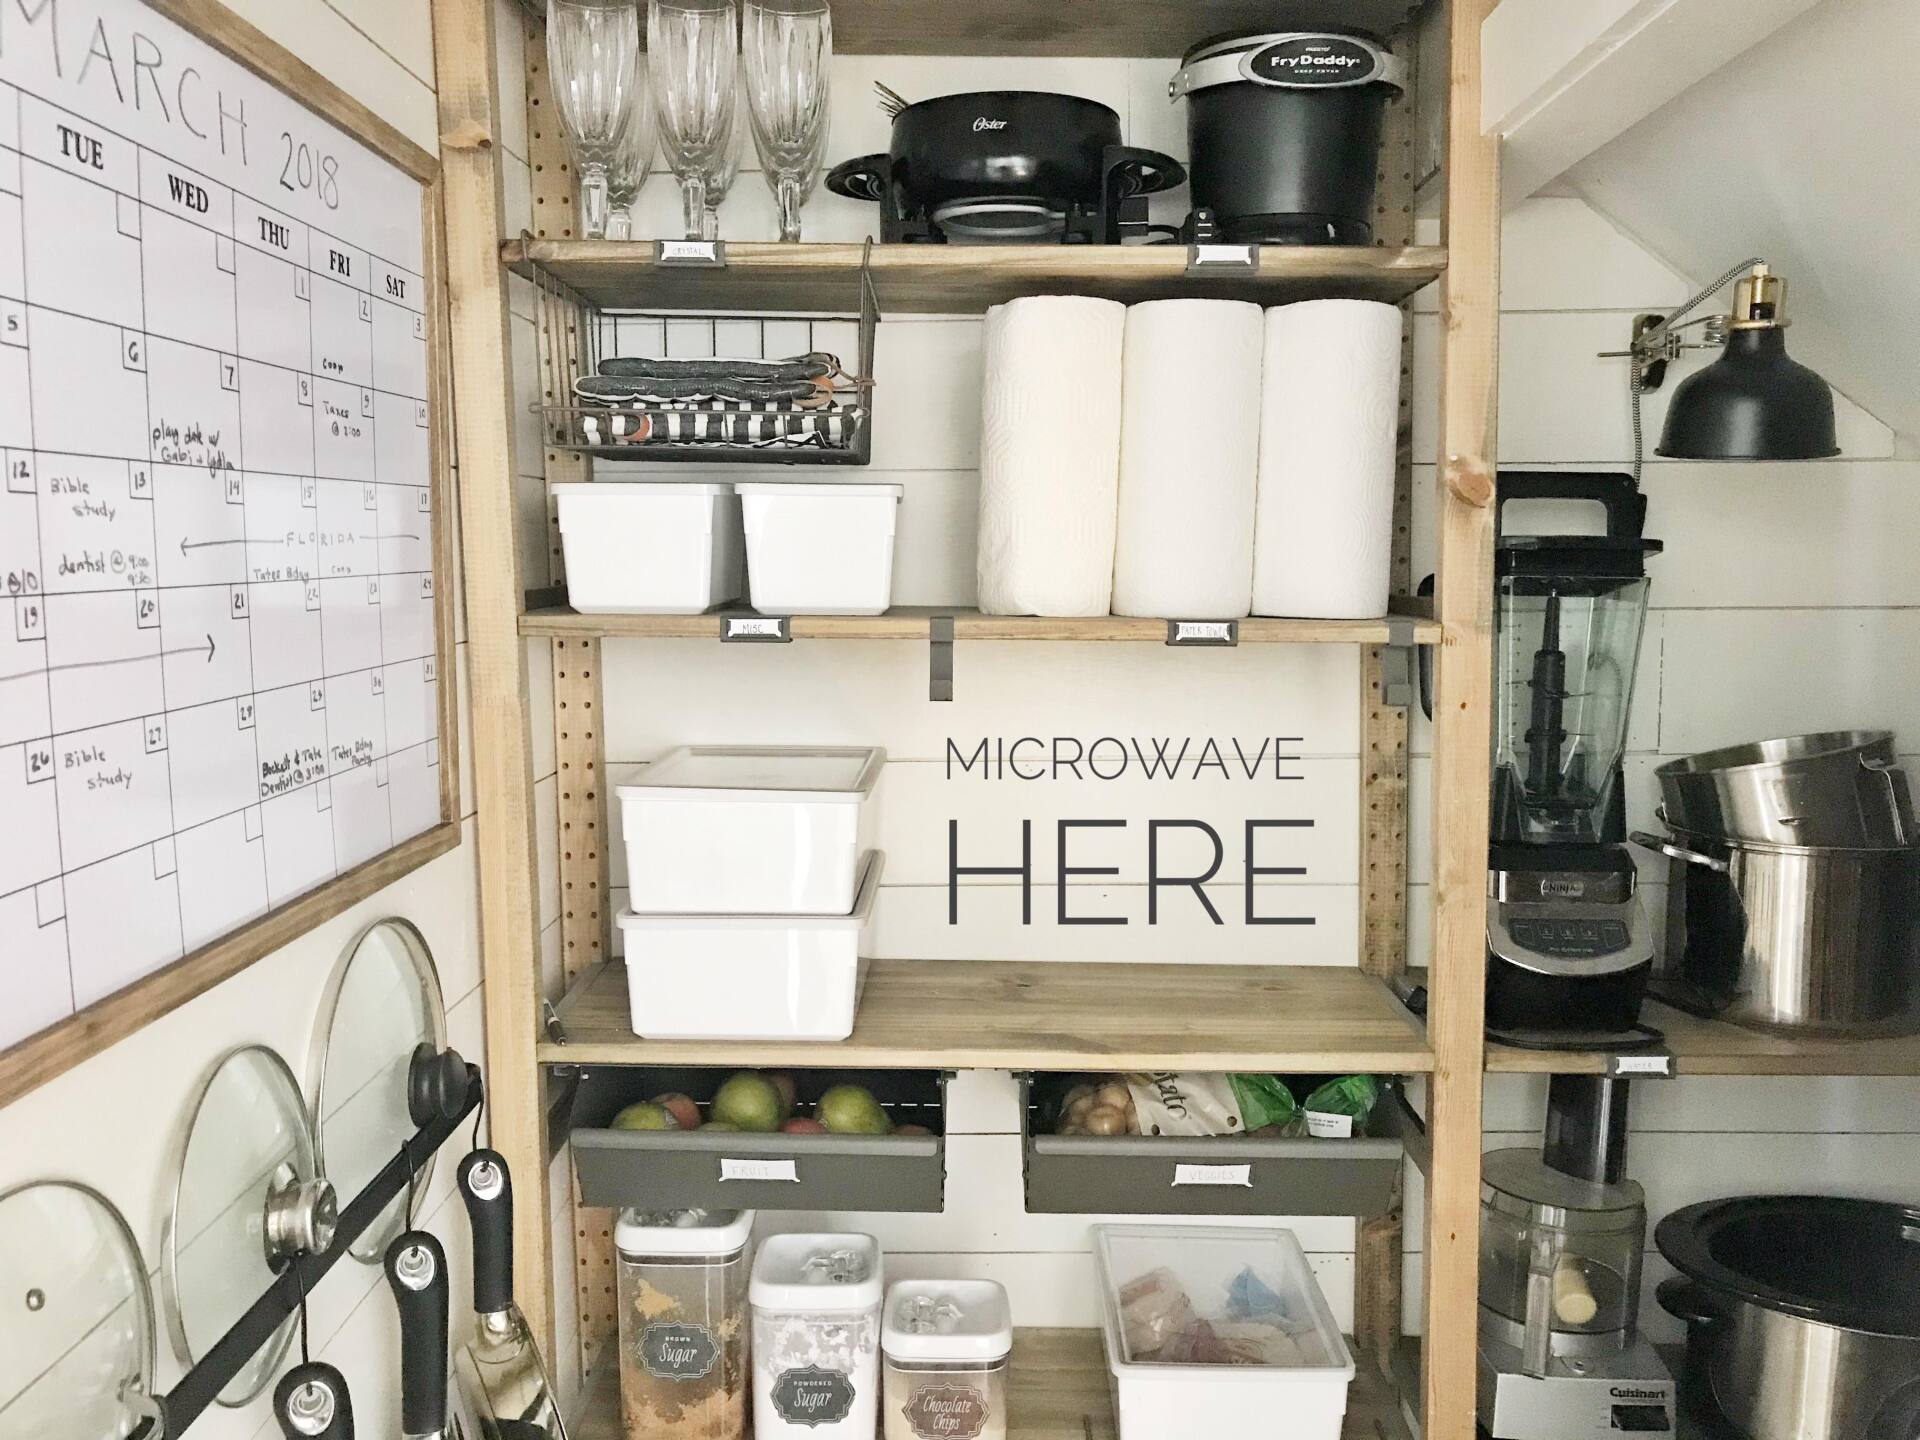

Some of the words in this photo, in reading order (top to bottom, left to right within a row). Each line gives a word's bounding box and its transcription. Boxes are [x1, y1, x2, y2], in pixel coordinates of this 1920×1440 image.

[1271, 55, 1356, 67] FryDaddy
[0, 0, 248, 166] MARCH
[279, 131, 340, 210] 2018
[973, 117, 1007, 131] Oster
[57, 124, 104, 170] TUE
[167, 173, 209, 215] WED
[258, 216, 290, 250] THU
[329, 249, 351, 278] FRI
[386, 274, 406, 299] SAT
[362, 301, 369, 317] 2
[7, 315, 18, 331] 5
[415, 318, 421, 332] 3
[128, 341, 139, 362] 6
[225, 365, 234, 386] 7
[301, 380, 308, 397] 8
[364, 394, 370, 408] 9
[418, 406, 426, 419] 10
[153, 417, 179, 450] play
[13, 461, 30, 478] 12
[50, 477, 90, 494] Bible
[134, 472, 146, 490] 13
[229, 480, 240, 495] 14
[303, 486, 314, 499] 15
[72, 500, 116, 521] study
[286, 531, 354, 547] FLORIDA
[58, 550, 105, 576] dentist
[235, 594, 244, 608] 21
[307, 588, 318, 600] 22
[24, 606, 38, 629] 19
[140, 600, 155, 618] 20
[742, 624, 763, 634] MISC
[426, 664, 433, 674] 31
[149, 727, 161, 745] 27
[31, 754, 49, 772] 26
[64, 746, 106, 768] Bible
[947, 737, 1304, 780] MICROWAVE
[88, 768, 132, 789] study
[949, 819, 1316, 925] HERE
[659, 1343, 697, 1368] Sugar
[794, 1388, 832, 1413] Sugar
[1610, 1387, 1665, 1399] Cuisinart
[923, 1396, 971, 1414] Chocolate
[933, 1412, 961, 1435] Chips
